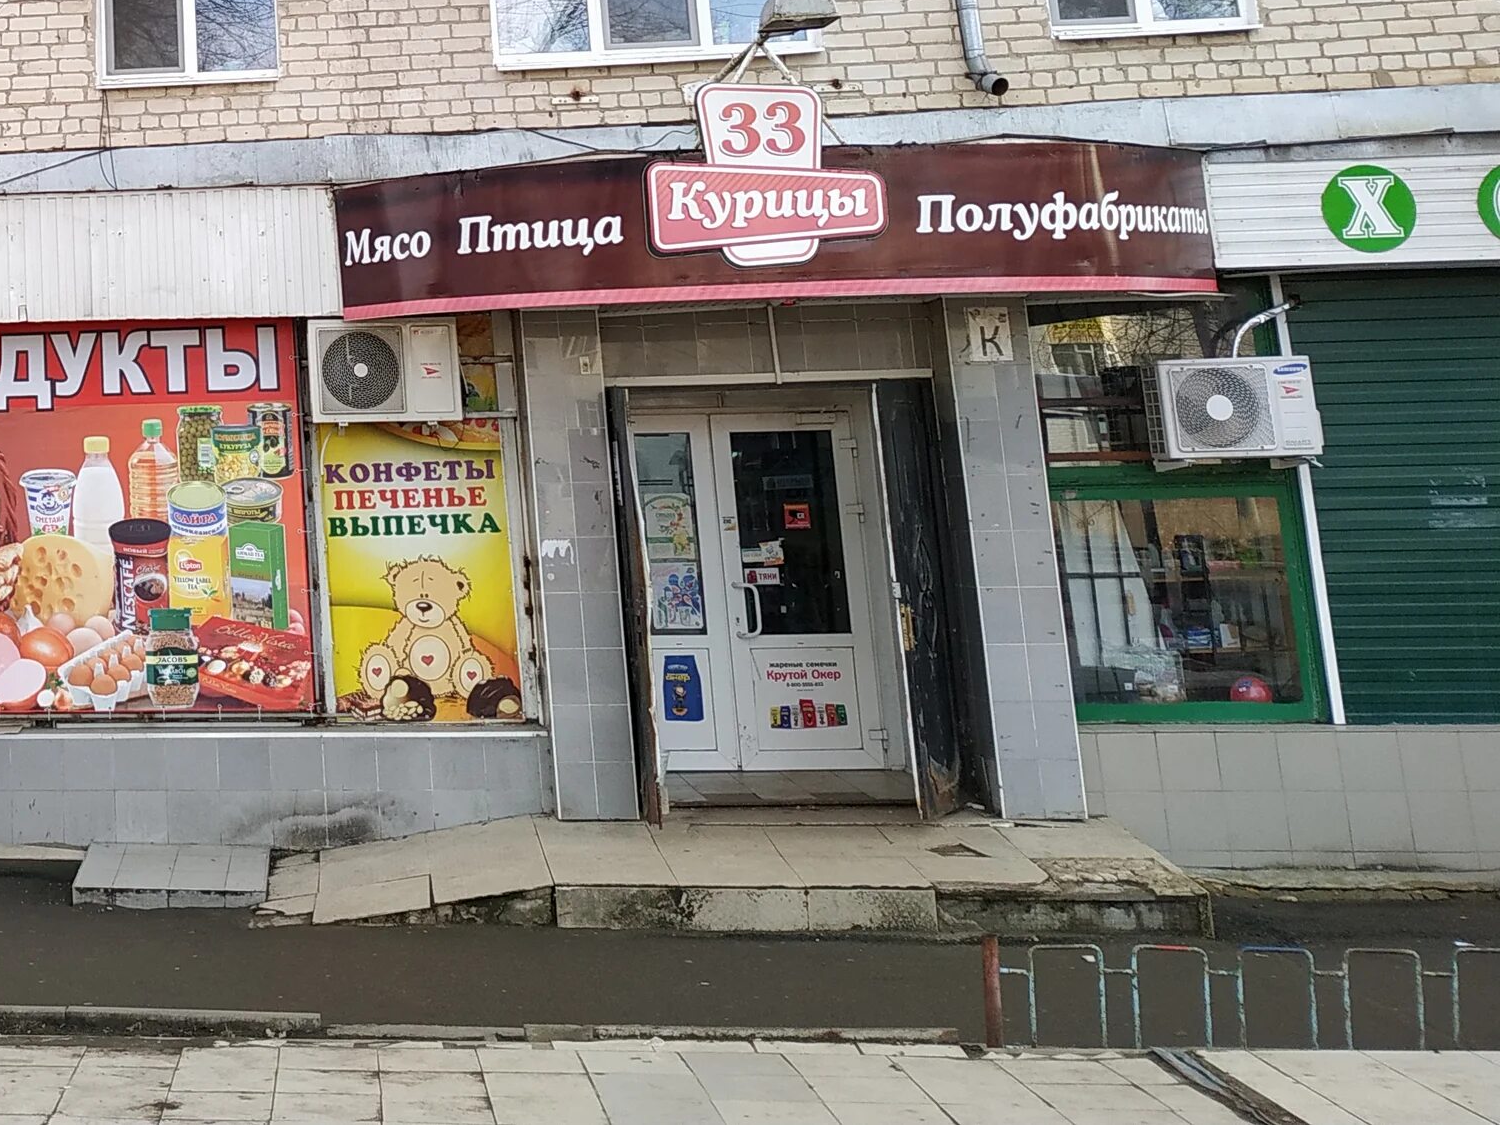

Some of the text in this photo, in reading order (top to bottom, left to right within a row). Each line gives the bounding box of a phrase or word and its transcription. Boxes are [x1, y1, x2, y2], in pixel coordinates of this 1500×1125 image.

[719, 100, 806, 159] 33
[667, 181, 870, 230] Курицы
[915, 190, 1209, 241] Полуфабрикаты
[343, 214, 624, 267] Мясо Птица
[324, 458, 496, 484] КОНФЕТЫ
[333, 485, 488, 511] ПЕЧЕНЬЕ
[173, 512, 218, 525] САЙРА
[328, 512, 501, 537] ВЫПЕЧКА
[180, 561, 201, 571] Lipton
[758, 572, 777, 580] ТЯНИ
[157, 656, 188, 665] JACOBS
[766, 669, 842, 682] Крутой Окер
